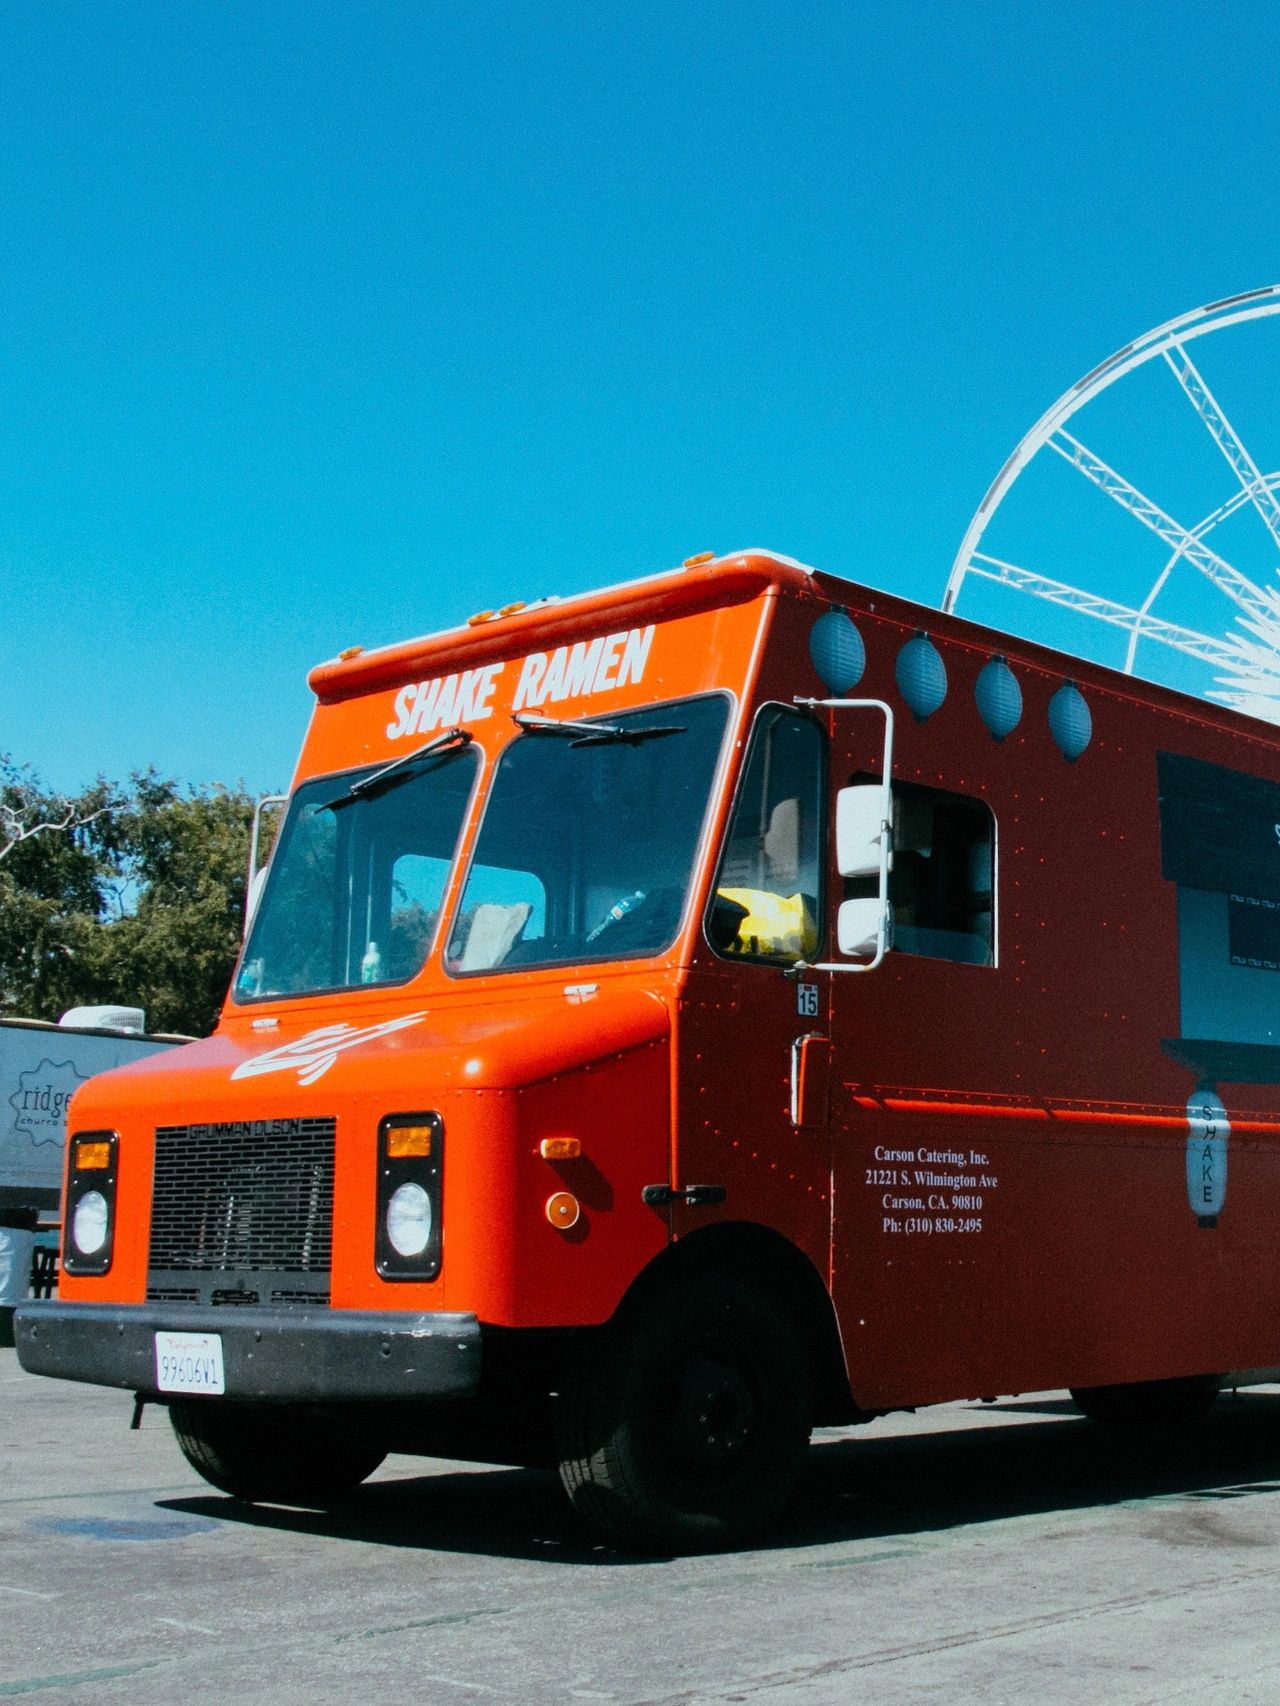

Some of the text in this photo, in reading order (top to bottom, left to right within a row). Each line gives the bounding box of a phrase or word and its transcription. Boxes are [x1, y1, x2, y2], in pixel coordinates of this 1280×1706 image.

[386, 624, 656, 740] SHAKE RAMEN
[800, 992, 817, 1014] 15
[874, 1145, 989, 1167] Carson Catering, Inc.
[1202, 1105, 1216, 1203] SHAKE
[865, 1169, 998, 1190] 21221 S. Wilmington Ave
[882, 1194, 982, 1211] Carson, CA. 90810
[883, 1217, 982, 1235] Ph: (310) 830-2495
[162, 1355, 218, 1385] 99606V1
